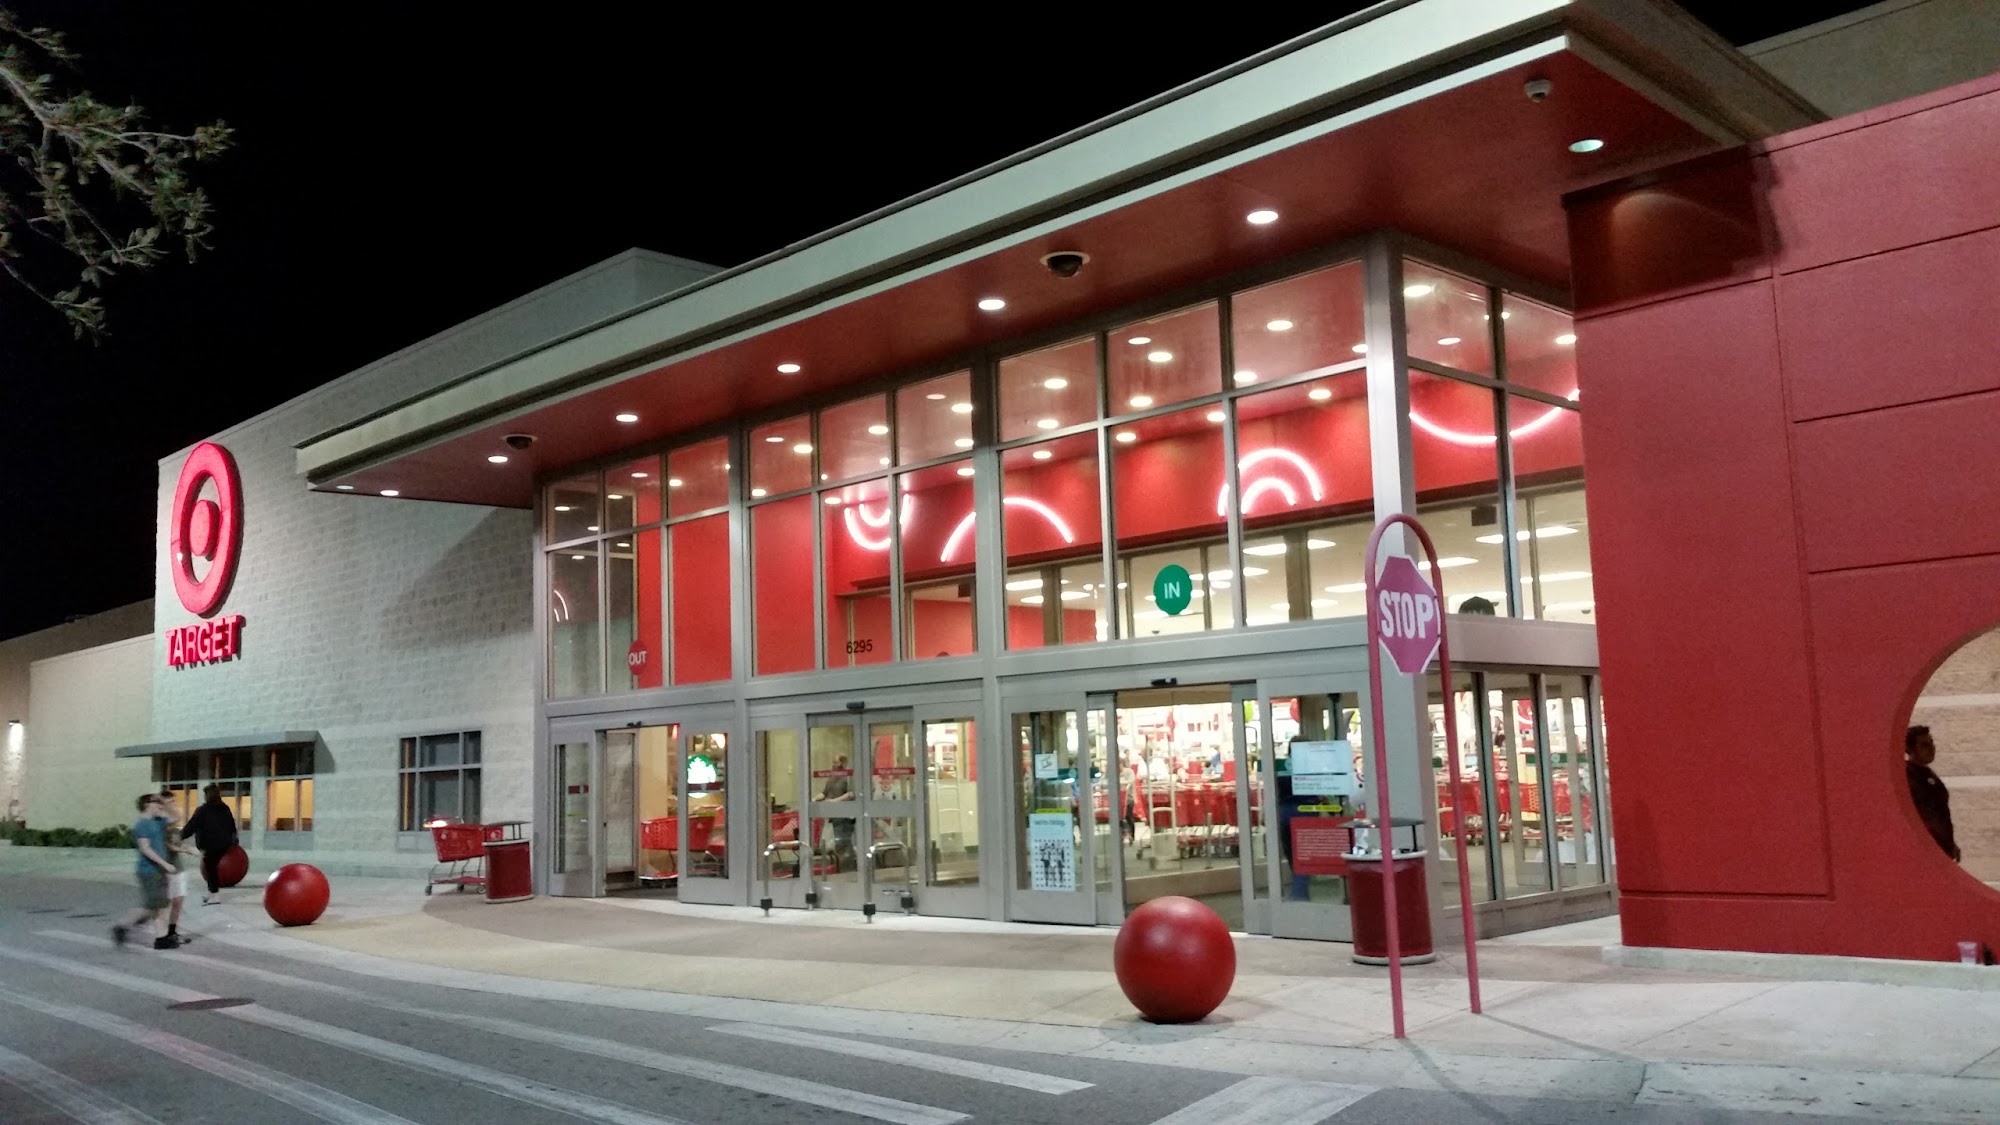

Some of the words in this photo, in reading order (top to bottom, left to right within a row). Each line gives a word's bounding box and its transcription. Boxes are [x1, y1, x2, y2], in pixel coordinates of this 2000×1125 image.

[1164, 581, 1180, 599] IN
[1379, 589, 1434, 639] STOP
[165, 615, 238, 667] TARGET
[846, 639, 873, 654] 6295
[629, 650, 647, 665] OUT
